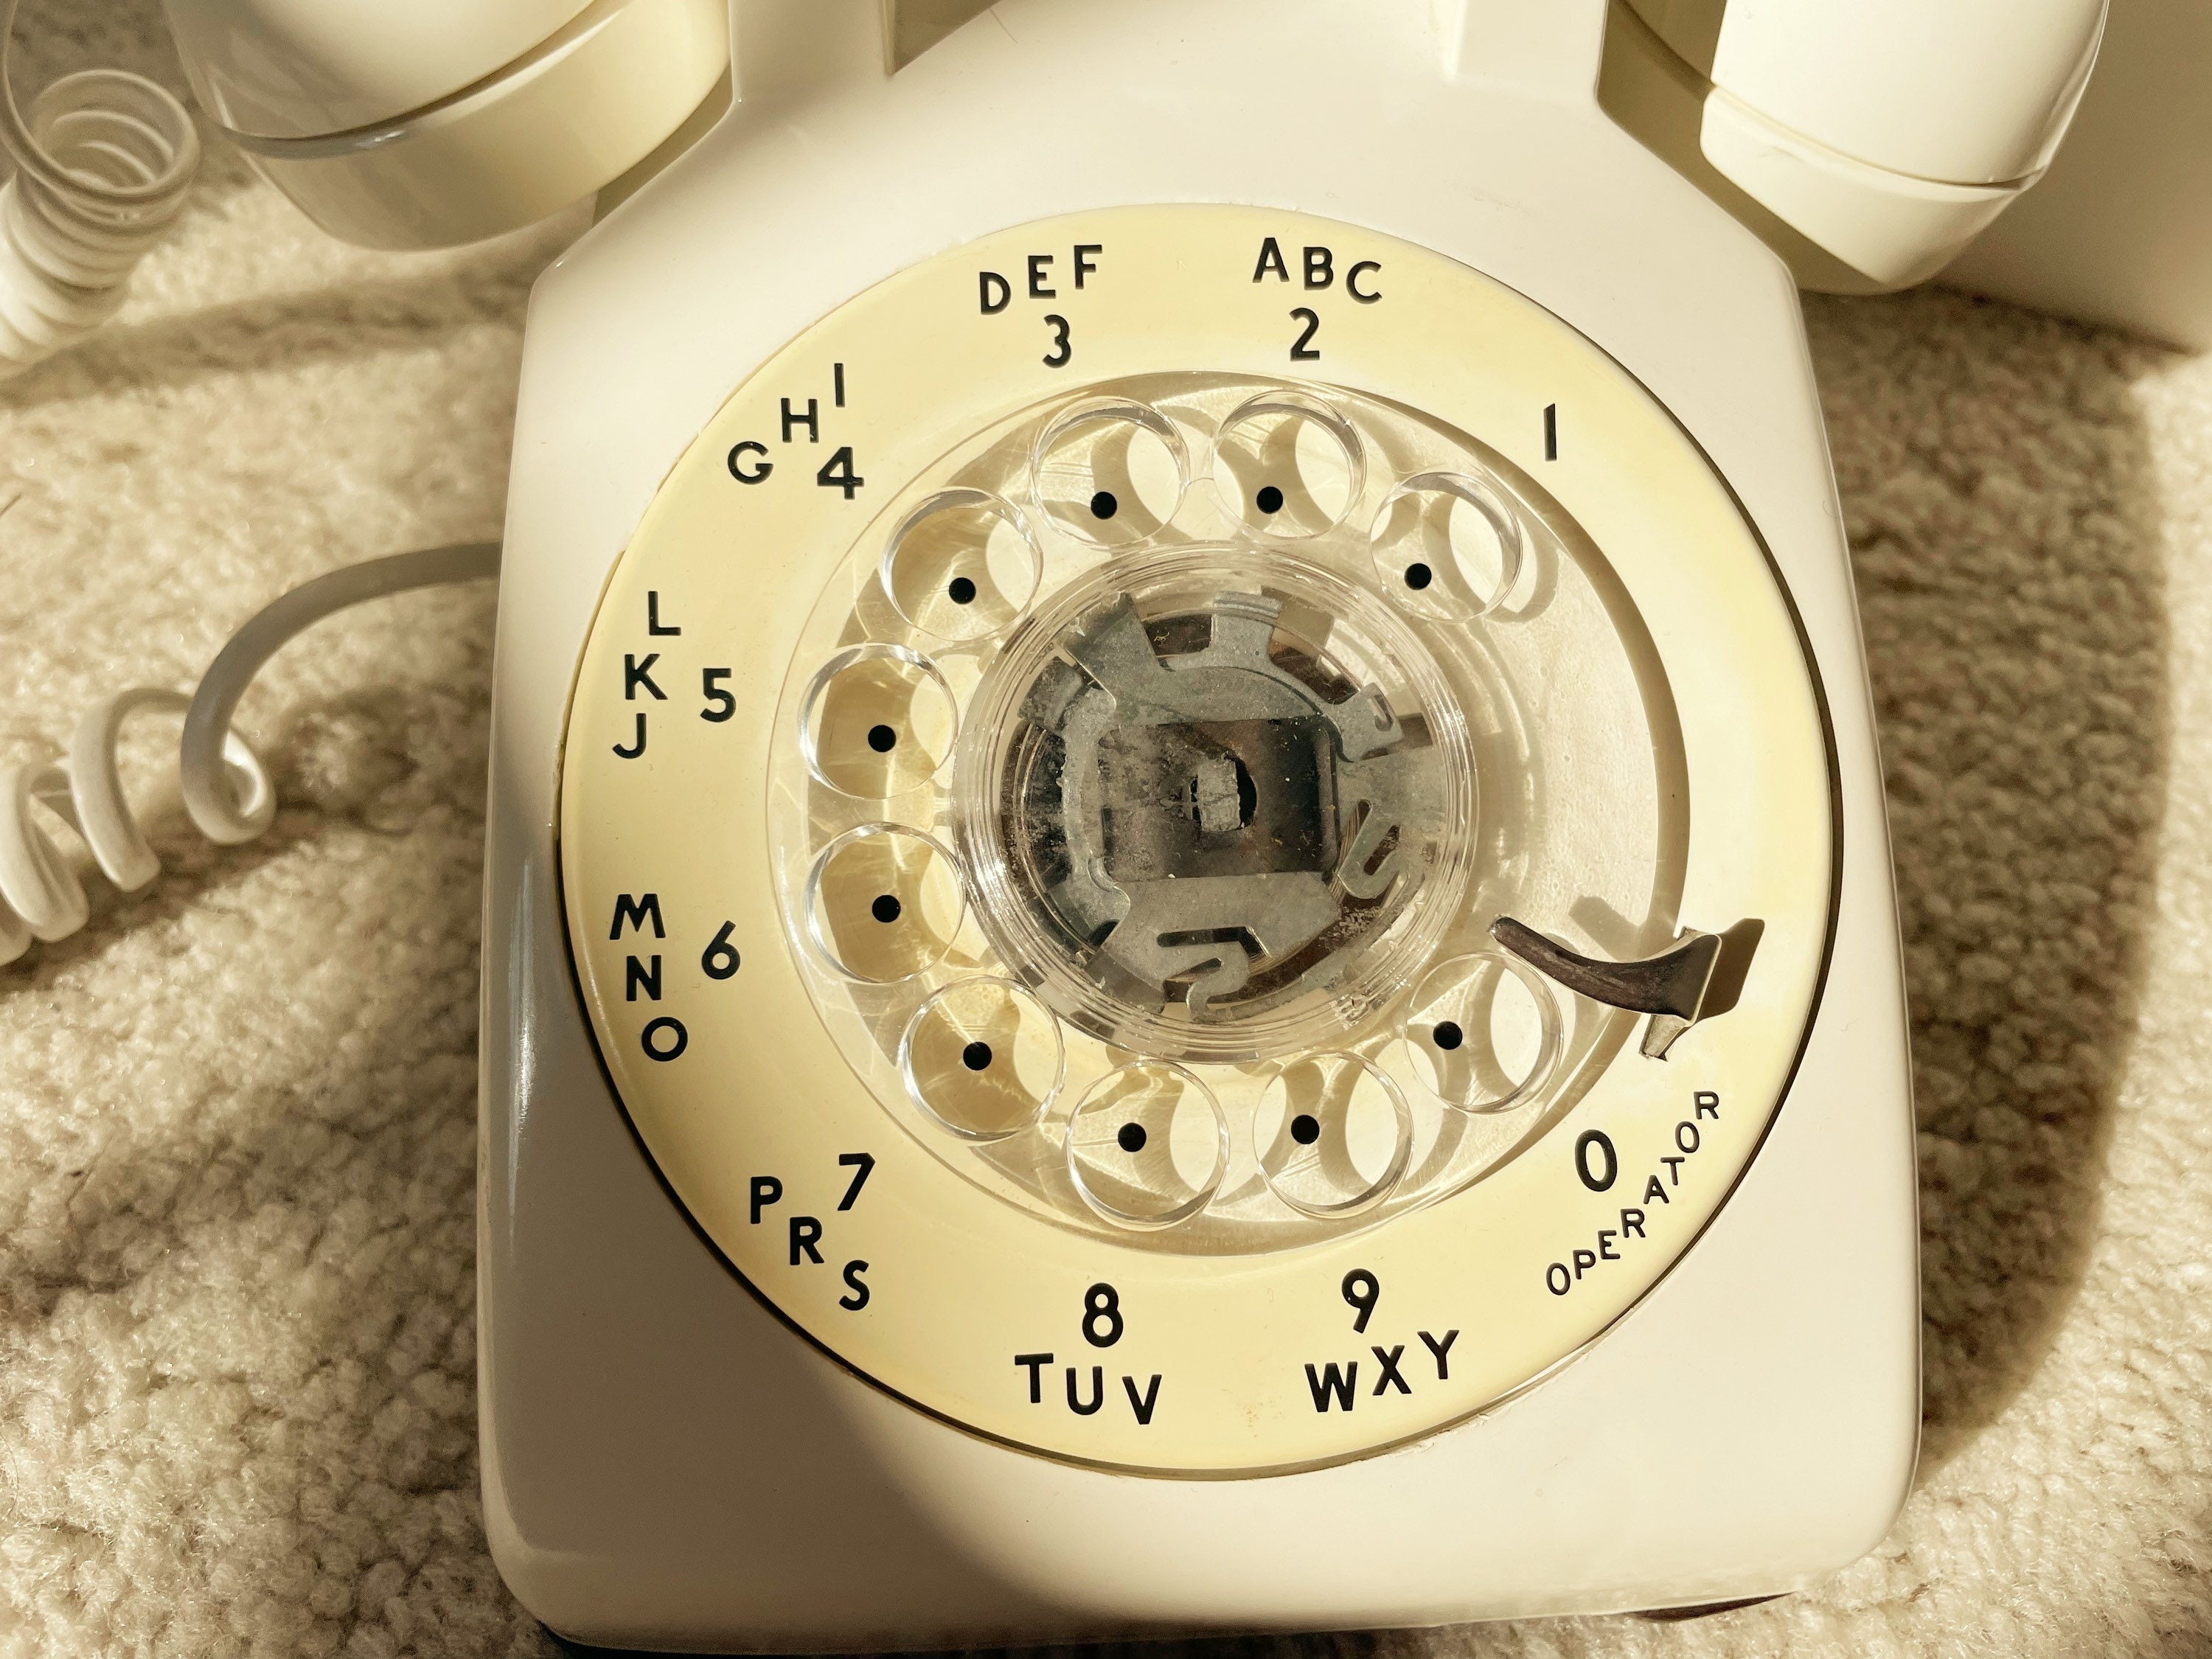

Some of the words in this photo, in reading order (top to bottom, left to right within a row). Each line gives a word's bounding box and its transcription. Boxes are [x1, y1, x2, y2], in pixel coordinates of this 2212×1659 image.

[979, 244, 1102, 314] DEF
[1253, 237, 1382, 303] ABC
[1043, 314, 1072, 368] 3
[1290, 307, 1321, 361] 2
[727, 363, 845, 485] GHI
[816, 446, 864, 501] 4
[700, 667, 737, 723] 5
[609, 893, 689, 1063] MNO
[701, 920, 742, 981] 6
[837, 1152, 876, 1212] 7
[1545, 1091, 1720, 1296] OPERATOR
[1574, 1129, 1618, 1192] 0
[750, 1175, 871, 1311] PRS
[1082, 1282, 1124, 1349] 8
[1341, 1269, 1380, 1335] 9
[1014, 1352, 1163, 1426] TUV
[1304, 1329, 1460, 1413] WXY
